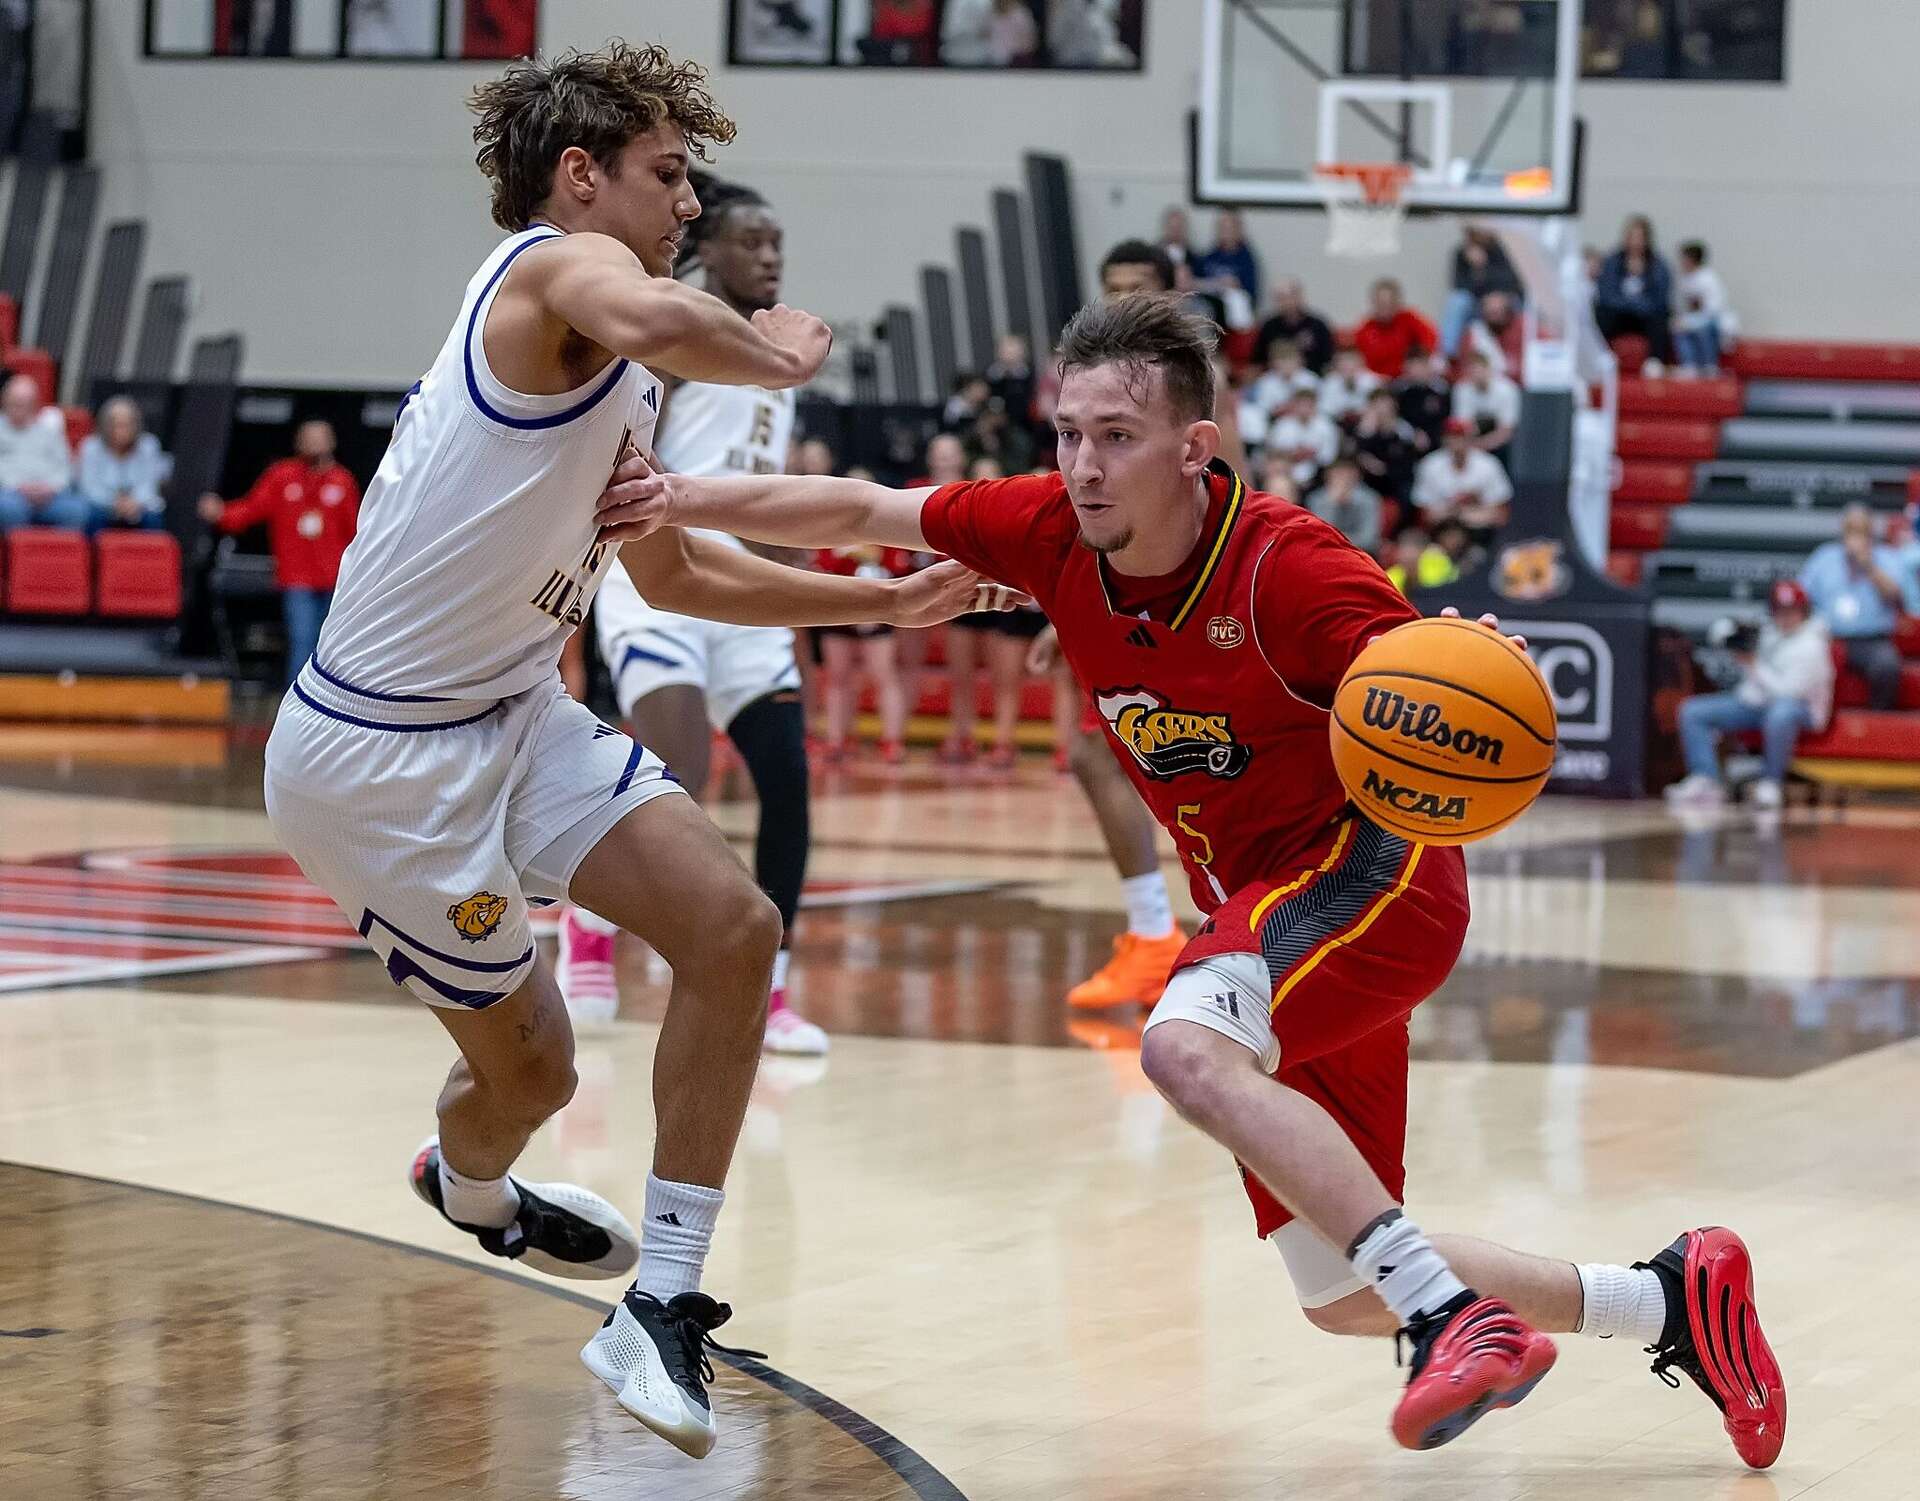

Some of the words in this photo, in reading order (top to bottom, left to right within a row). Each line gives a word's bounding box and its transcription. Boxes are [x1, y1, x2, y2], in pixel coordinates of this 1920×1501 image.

[1362, 686, 1505, 766] Wilson
[1361, 768, 1467, 821] NCAA
[1176, 803, 1214, 865] 5
